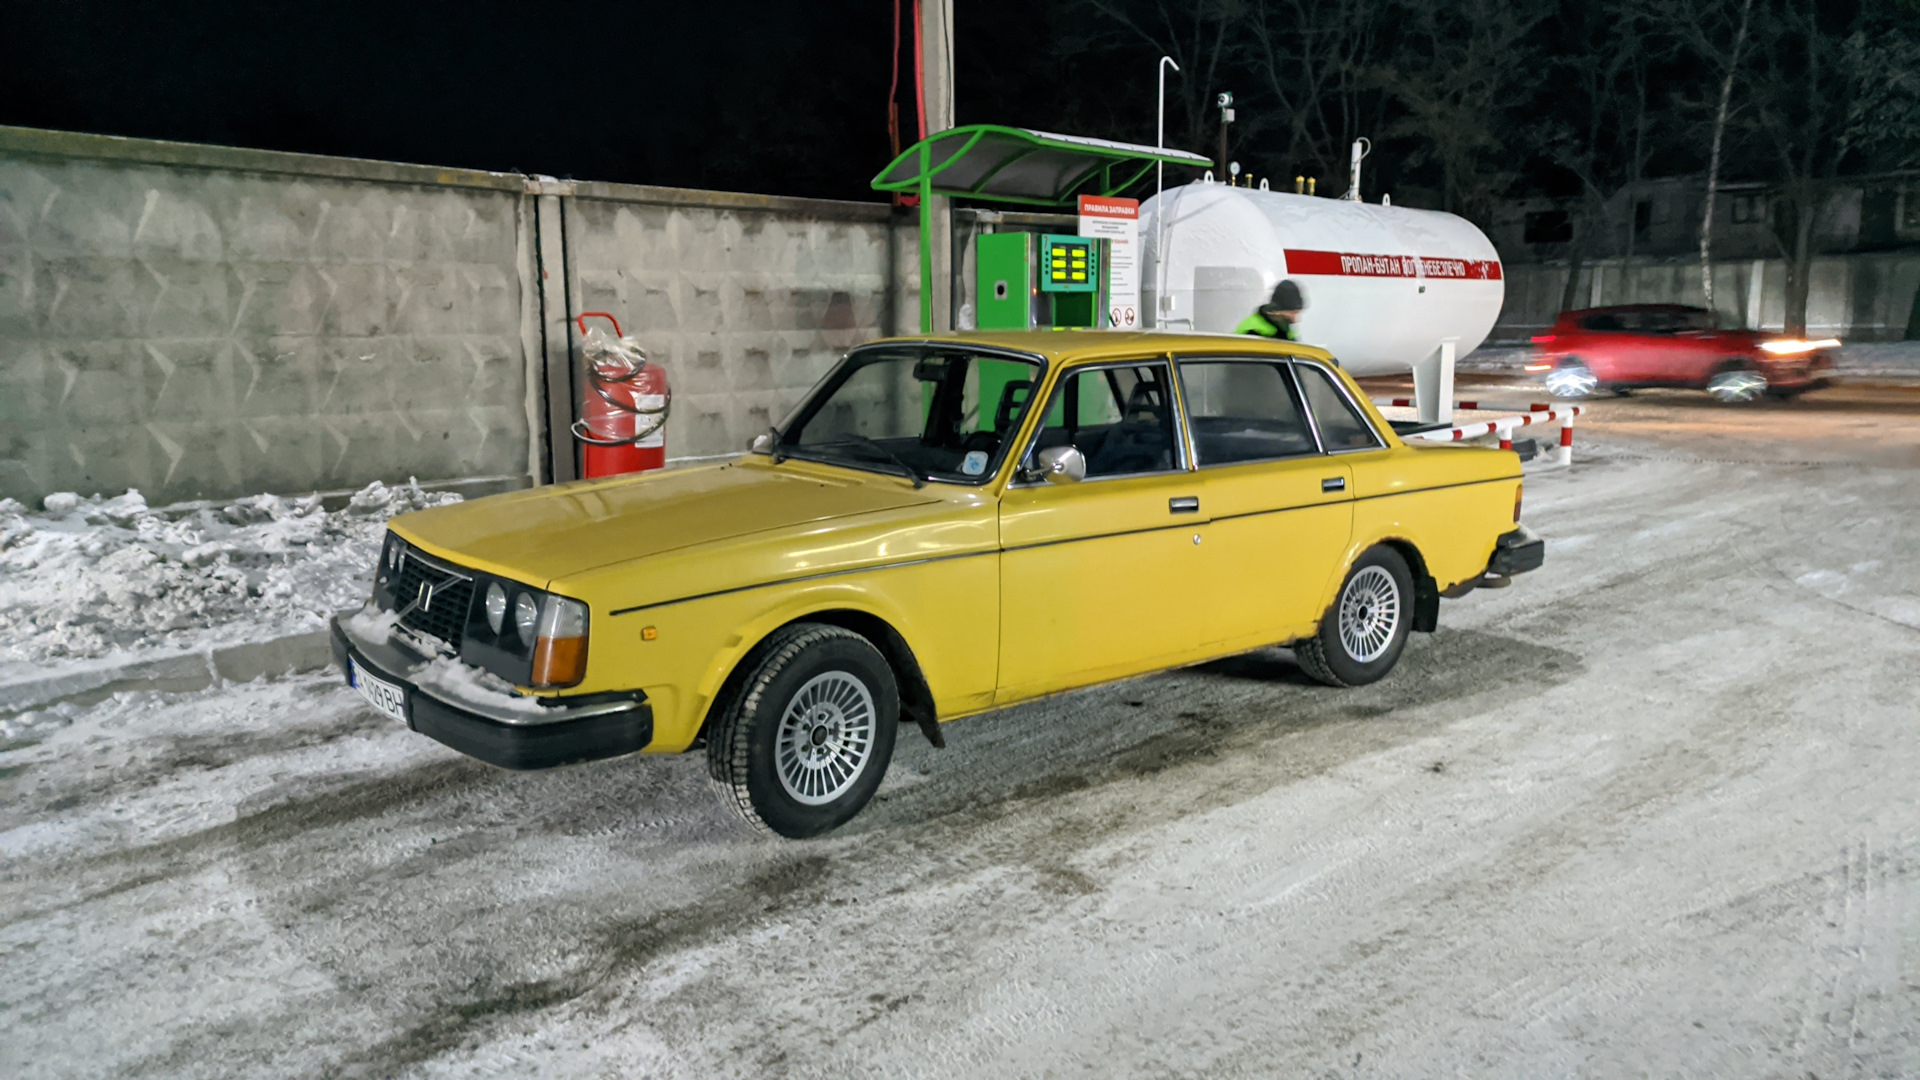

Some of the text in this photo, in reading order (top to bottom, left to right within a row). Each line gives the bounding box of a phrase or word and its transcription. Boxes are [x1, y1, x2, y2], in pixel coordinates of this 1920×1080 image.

[1084, 203, 1135, 215] ПРАВИЛА ЗАПРАВКИ
[1340, 255, 1466, 277] ПРОПАН-БУТАН ВОГНЕБЕЗПЕЧНО
